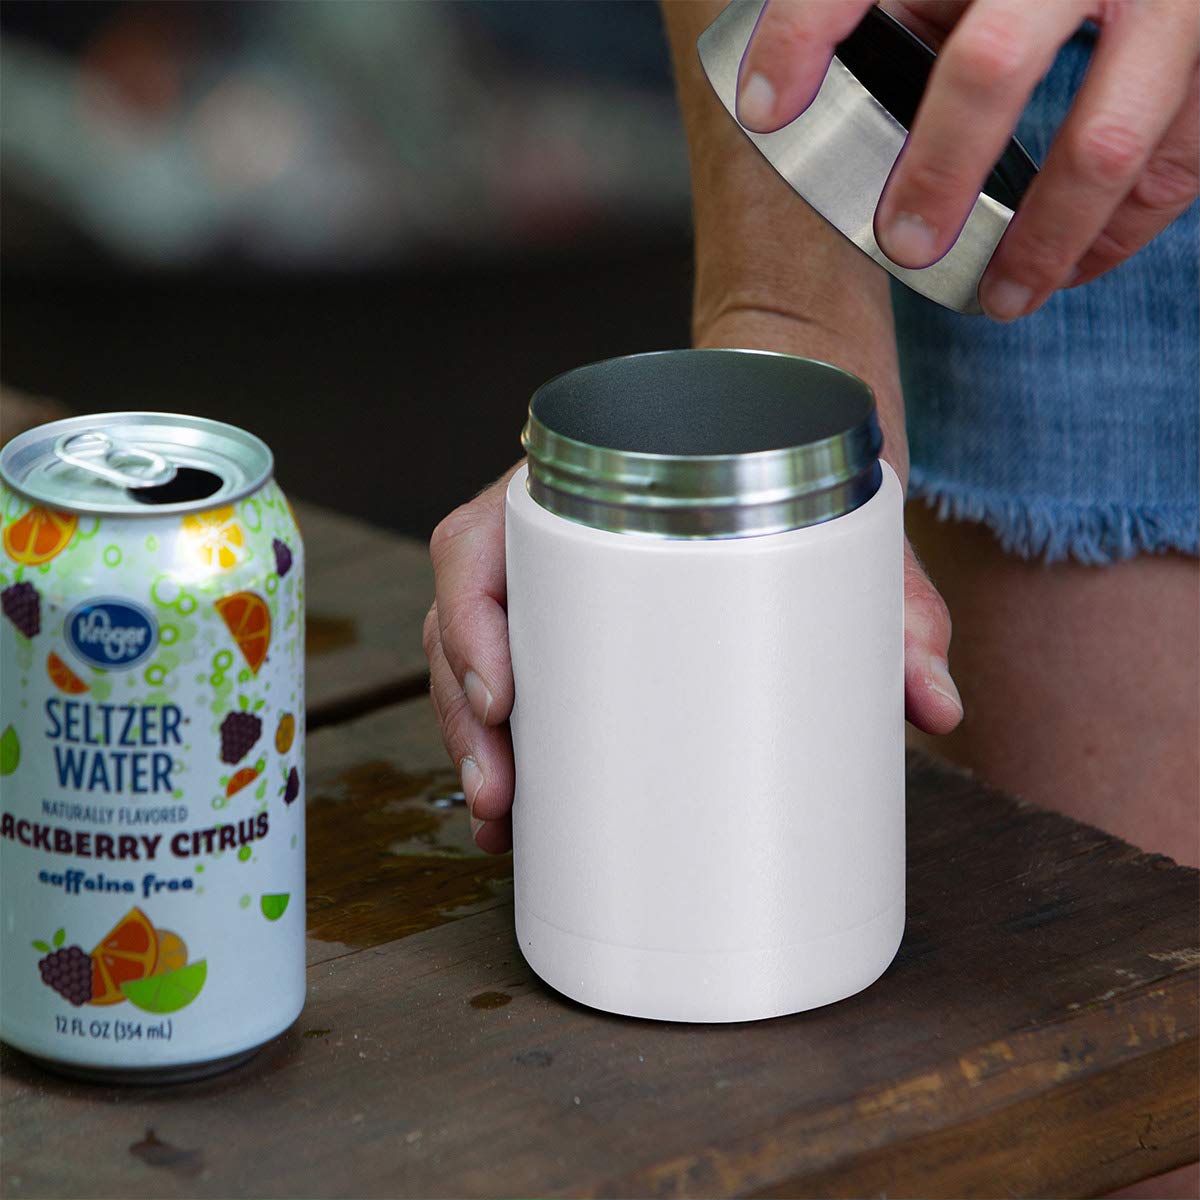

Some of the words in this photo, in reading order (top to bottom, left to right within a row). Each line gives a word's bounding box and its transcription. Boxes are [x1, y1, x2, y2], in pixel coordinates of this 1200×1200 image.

[78, 608, 147, 660] Kroger
[45, 699, 183, 746] SELTZER
[54, 747, 174, 793] WATER
[0, 812, 162, 861] ACKBERRY
[170, 811, 269, 858] CITRUS
[41, 800, 114, 824] NATURALLY
[118, 806, 188, 826] FLAVORED
[38, 868, 135, 895] caffeine
[142, 873, 194, 898] free
[56, 1015, 68, 1034] 12
[71, 1017, 86, 1037] FL
[89, 1020, 111, 1039] OZ
[115, 1019, 142, 1041] (354
[147, 1019, 172, 1041] mL)
